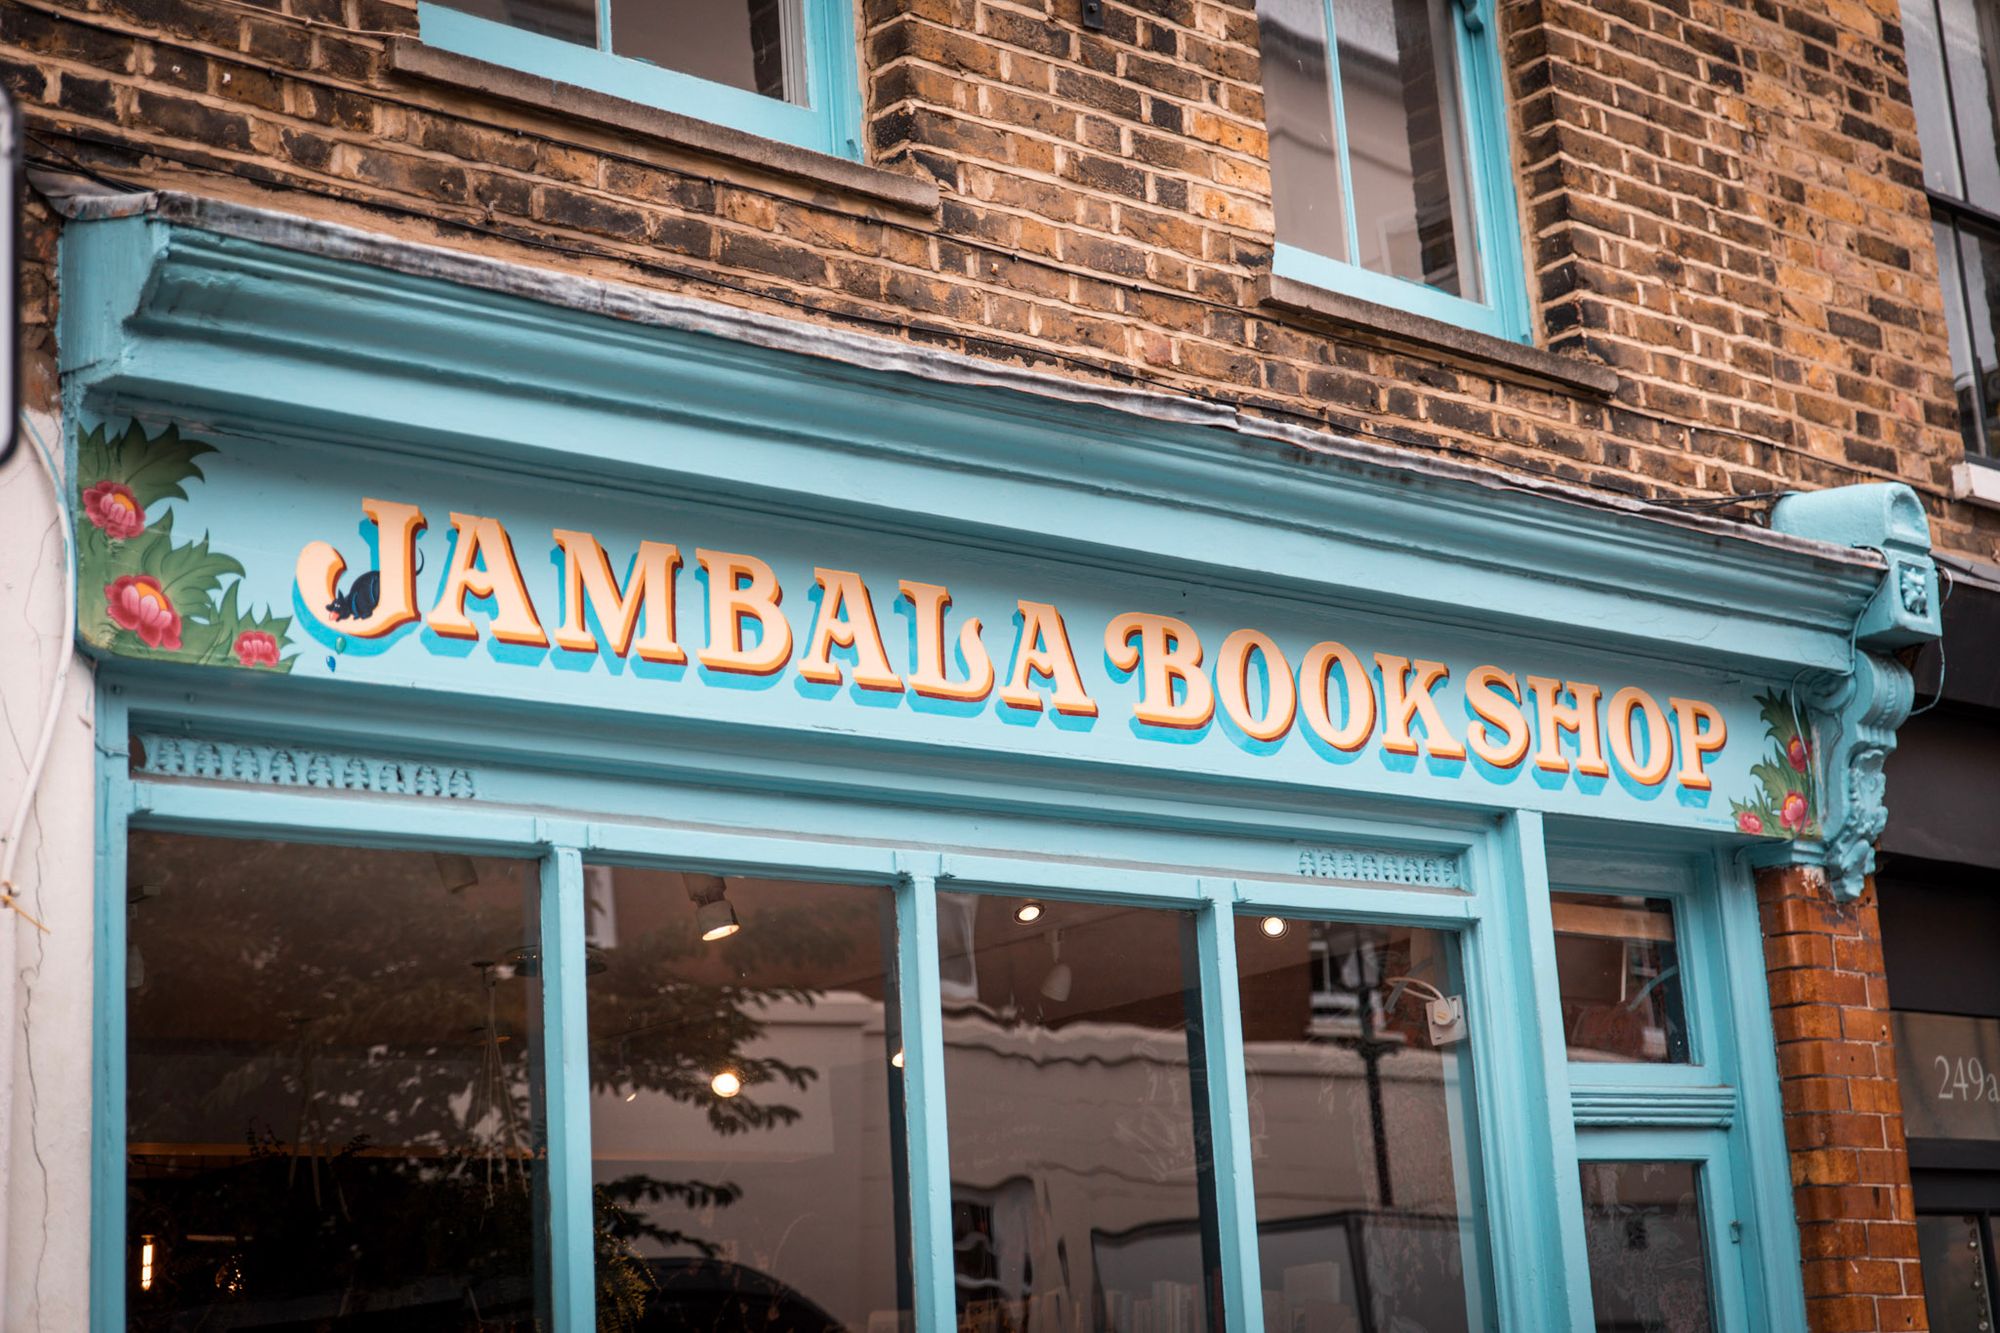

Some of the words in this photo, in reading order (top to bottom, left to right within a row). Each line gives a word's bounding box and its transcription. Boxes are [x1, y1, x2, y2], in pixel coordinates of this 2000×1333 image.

[295, 497, 1099, 719] JAMBALA
[1103, 612, 1727, 791] BOOKSHOP
[1935, 1055, 2000, 1103] 249a
